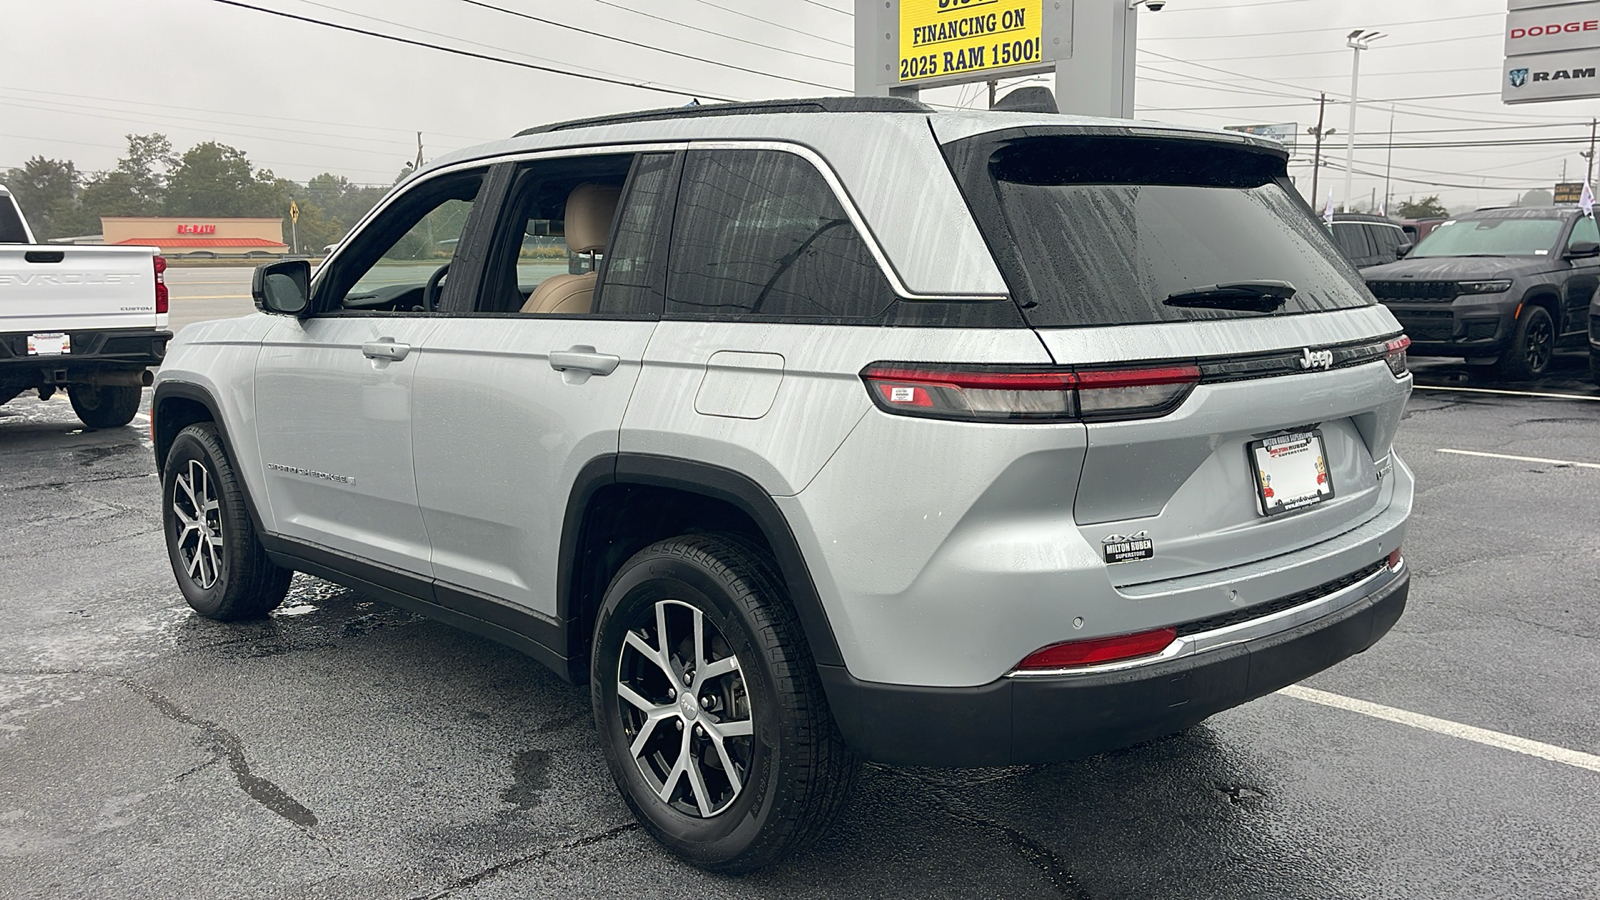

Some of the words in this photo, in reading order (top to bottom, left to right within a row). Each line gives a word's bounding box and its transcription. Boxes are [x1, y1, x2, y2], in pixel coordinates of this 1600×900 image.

[913, 13, 997, 45] FINANCING
[1002, 8, 1026, 30] ON
[1510, 20, 1599, 39] DODGE
[900, 54, 937, 78] 2025
[943, 46, 985, 72] RAM
[992, 37, 1040, 65] 1500!
[1532, 67, 1596, 82] RAM
[177, 224, 216, 234] RE-BATH
[1300, 347, 1333, 370] Jeep
[1288, 442, 1308, 451] RUBEN
[1106, 542, 1131, 554] MILTON
[1130, 539, 1152, 551] RUBEN
